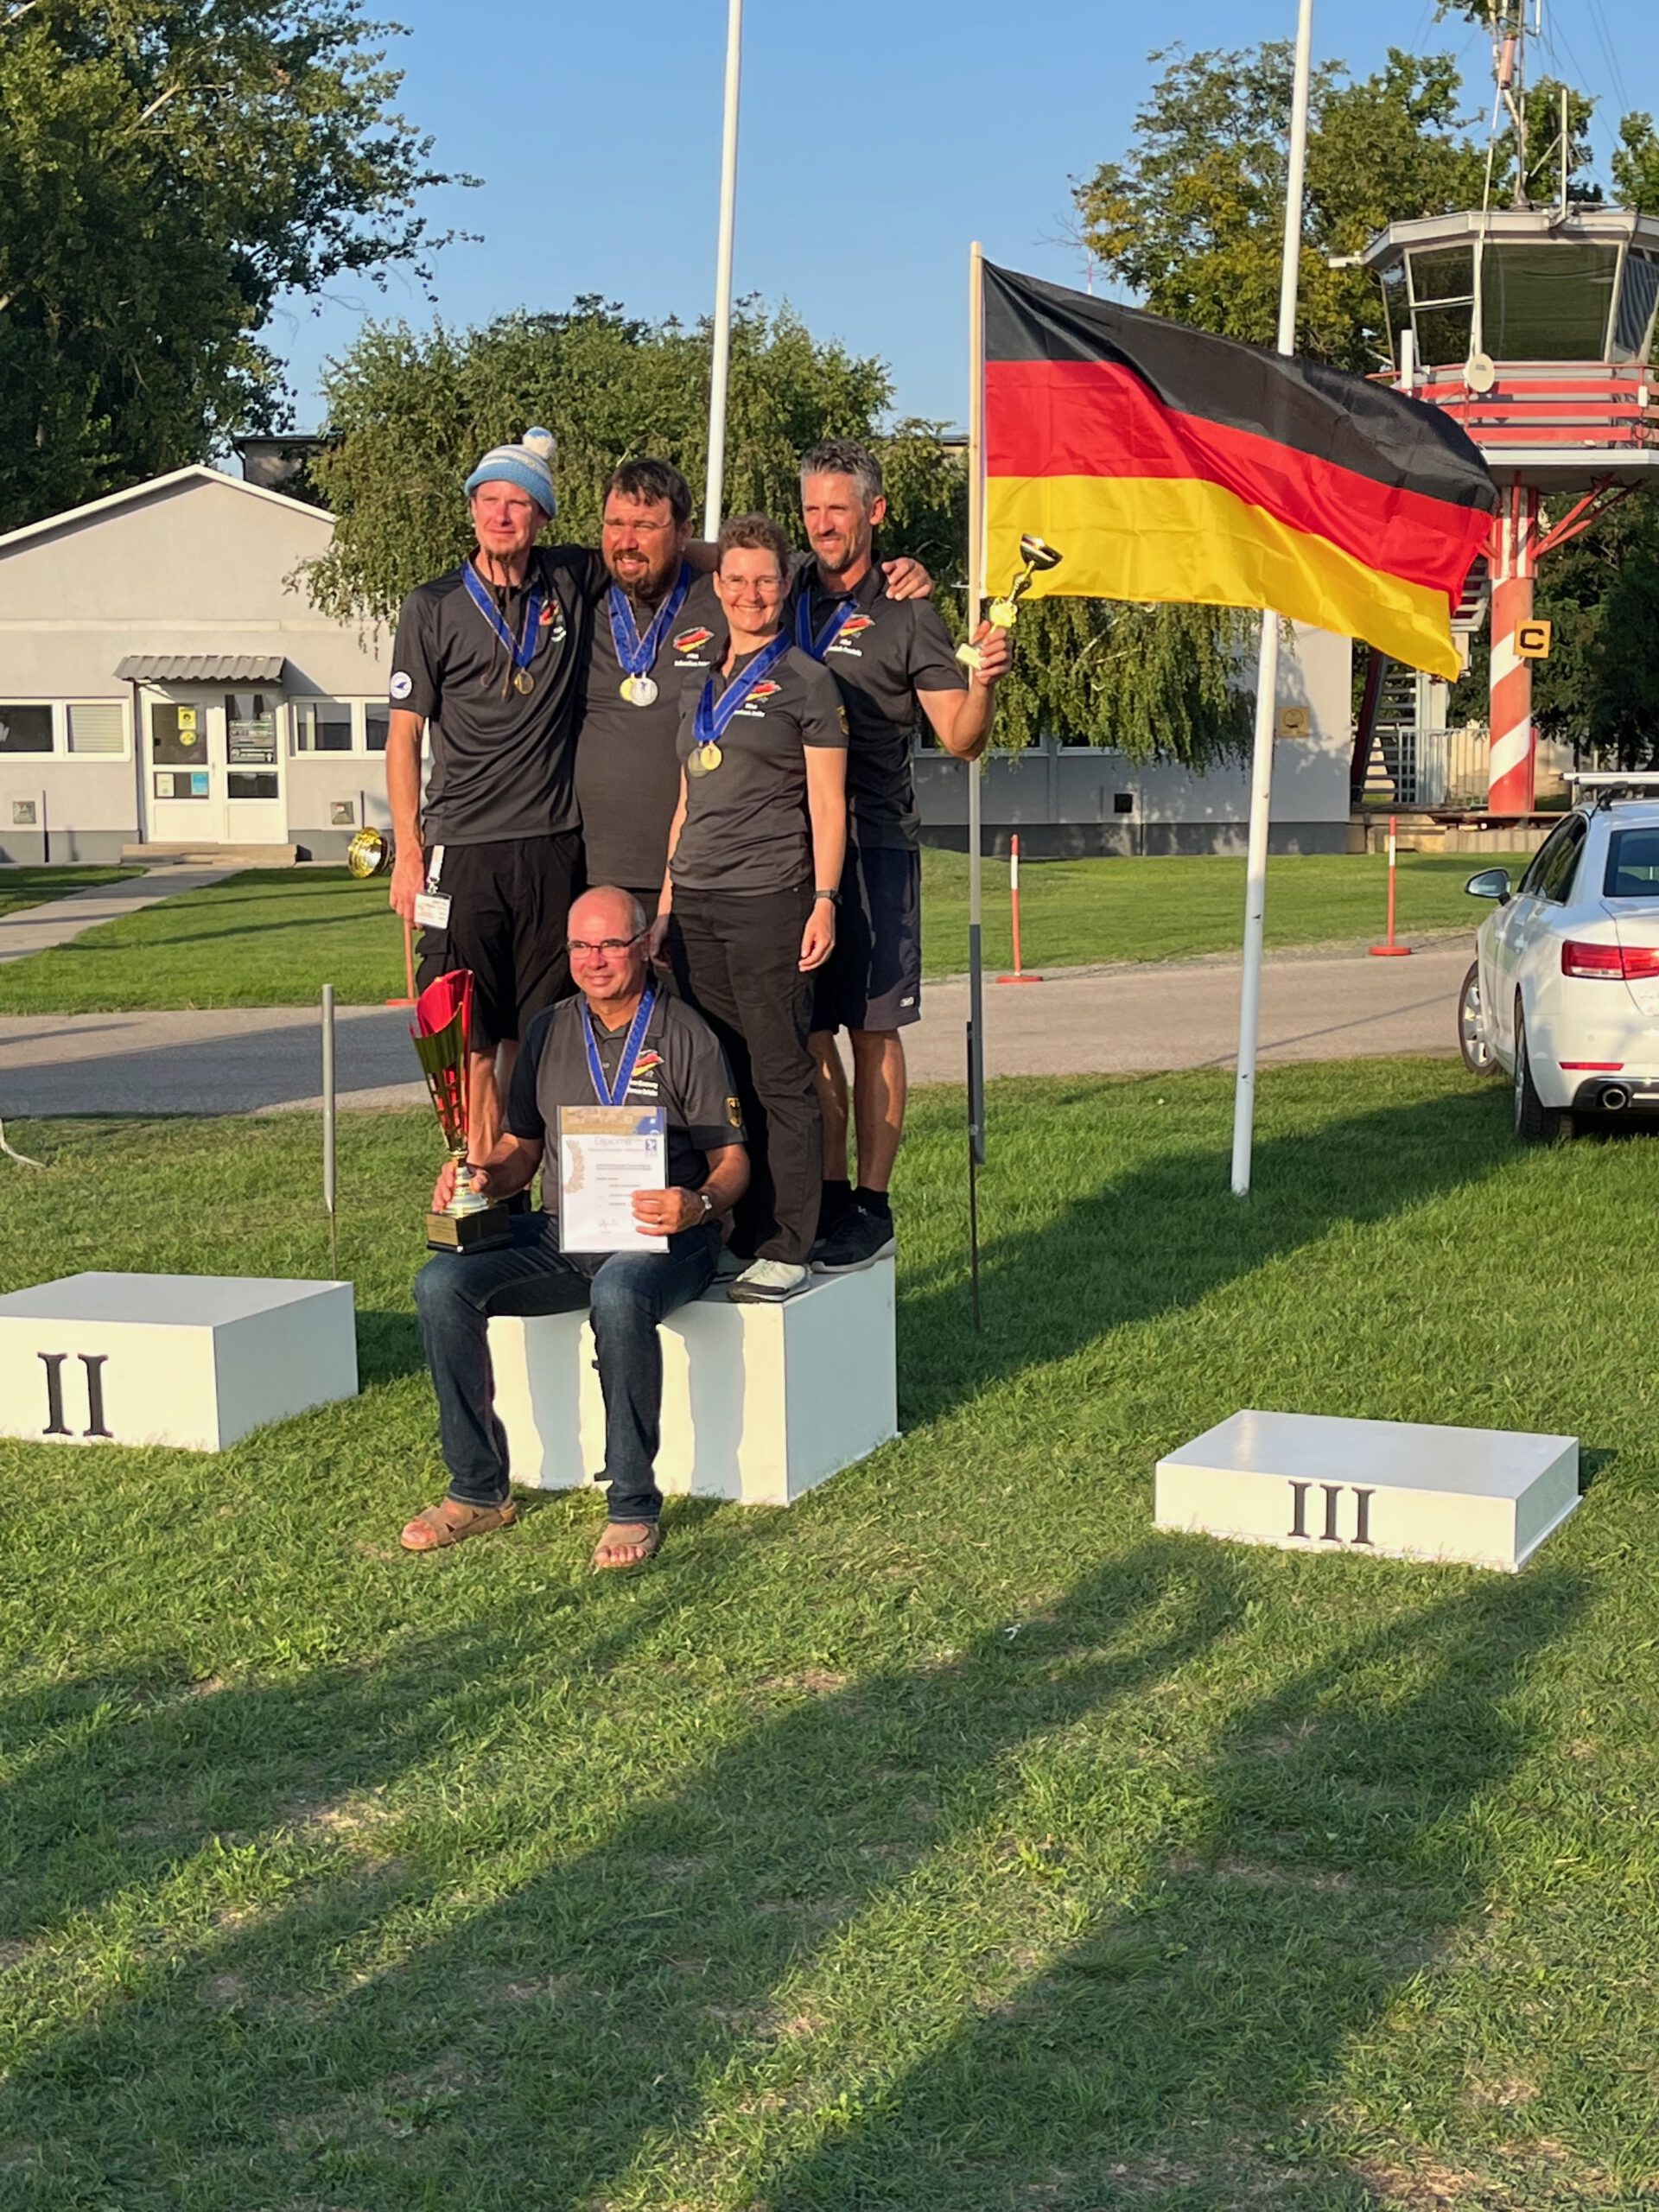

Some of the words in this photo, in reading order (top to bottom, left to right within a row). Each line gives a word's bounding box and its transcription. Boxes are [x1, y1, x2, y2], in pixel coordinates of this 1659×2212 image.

[1520, 628, 1544, 650] C
[37, 1351, 114, 1438] II
[1287, 1479, 1376, 1547] III
